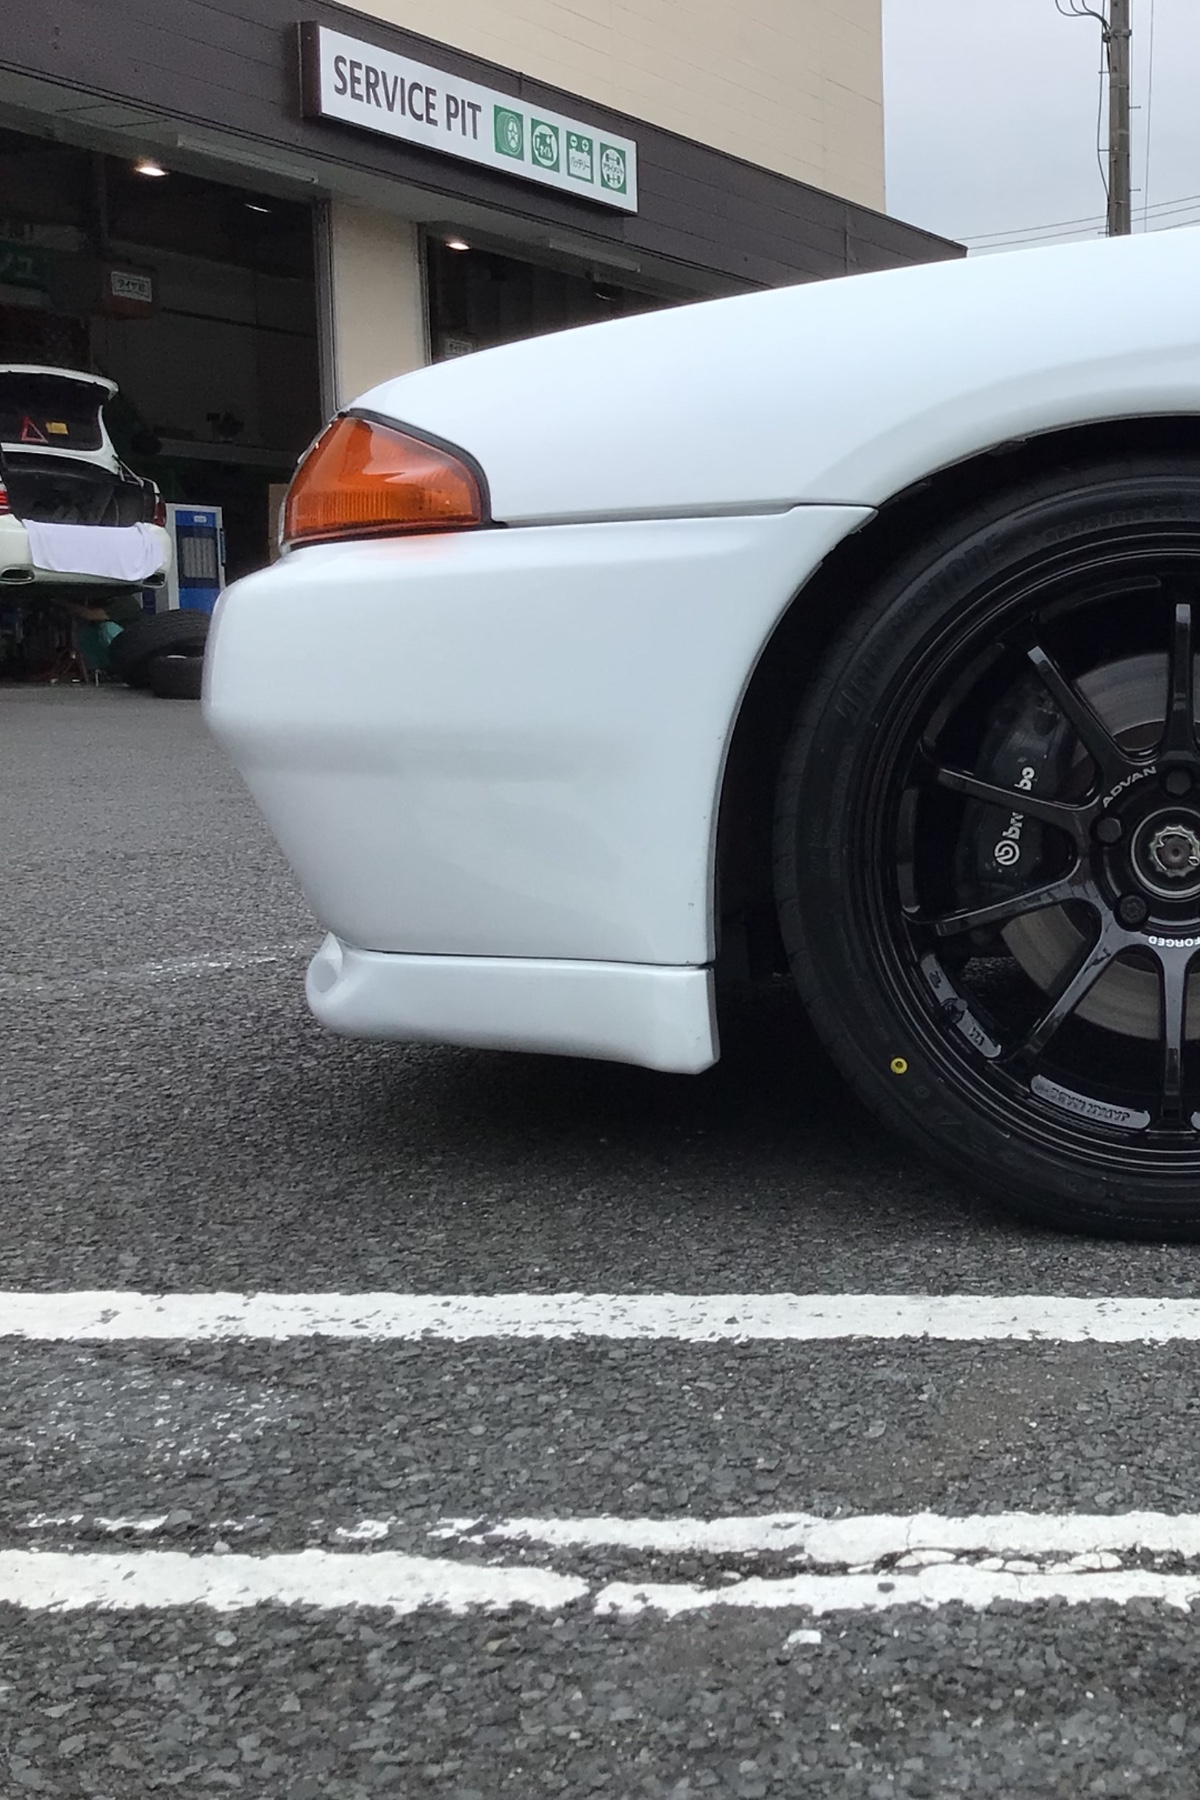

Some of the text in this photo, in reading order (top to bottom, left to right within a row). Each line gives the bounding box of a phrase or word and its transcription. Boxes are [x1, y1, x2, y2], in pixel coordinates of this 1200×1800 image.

[334, 54, 482, 140] SERVICE PIT
[570, 155, 591, 172] バッテリー
[1101, 765, 1157, 809] ADVAN
